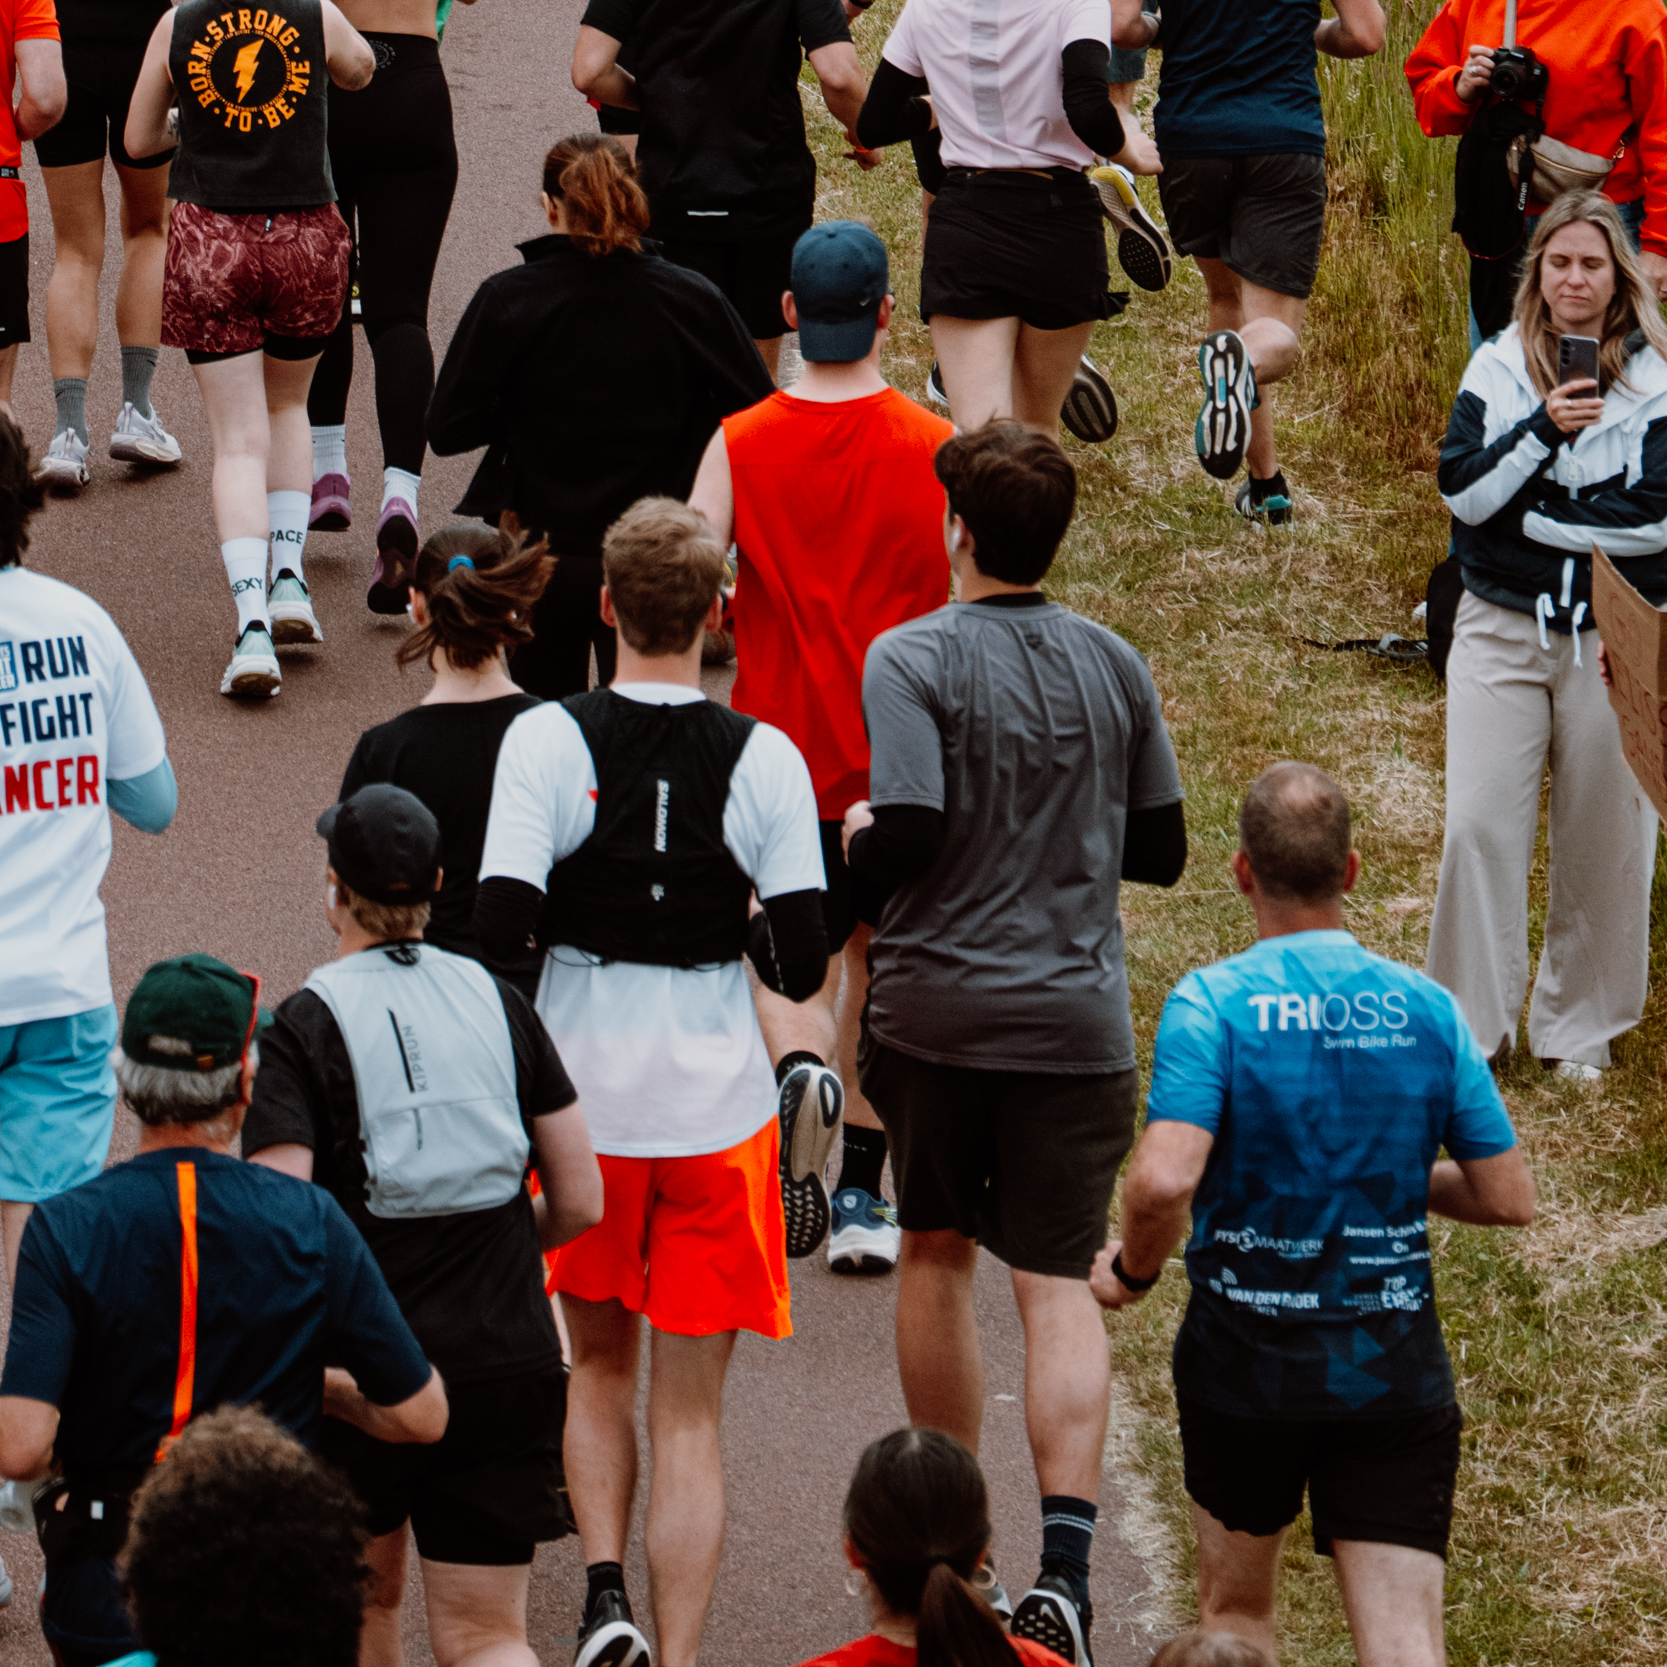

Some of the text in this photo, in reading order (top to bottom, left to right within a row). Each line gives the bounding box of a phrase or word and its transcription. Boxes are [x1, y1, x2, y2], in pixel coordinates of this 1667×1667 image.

[206, 8, 300, 47] STRONG
[187, 40, 215, 109] BORN
[288, 60, 310, 95] ME
[224, 106, 252, 132] TO
[263, 96, 295, 129] BE
[1517, 181, 1528, 211] Canon
[231, 577, 263, 597] SEXY
[21, 636, 90, 685] RUN
[0, 693, 93, 745] FIGHT
[654, 779, 669, 853] SALOMON
[1248, 992, 1409, 1032] TRIOSS
[401, 1025, 430, 1094] KIPRUN
[1324, 1035, 1418, 1050] Swim Bike Run
[1342, 1224, 1385, 1239] Jansen
[1226, 1288, 1255, 1303] VAN
[1255, 1291, 1281, 1306] DEN
